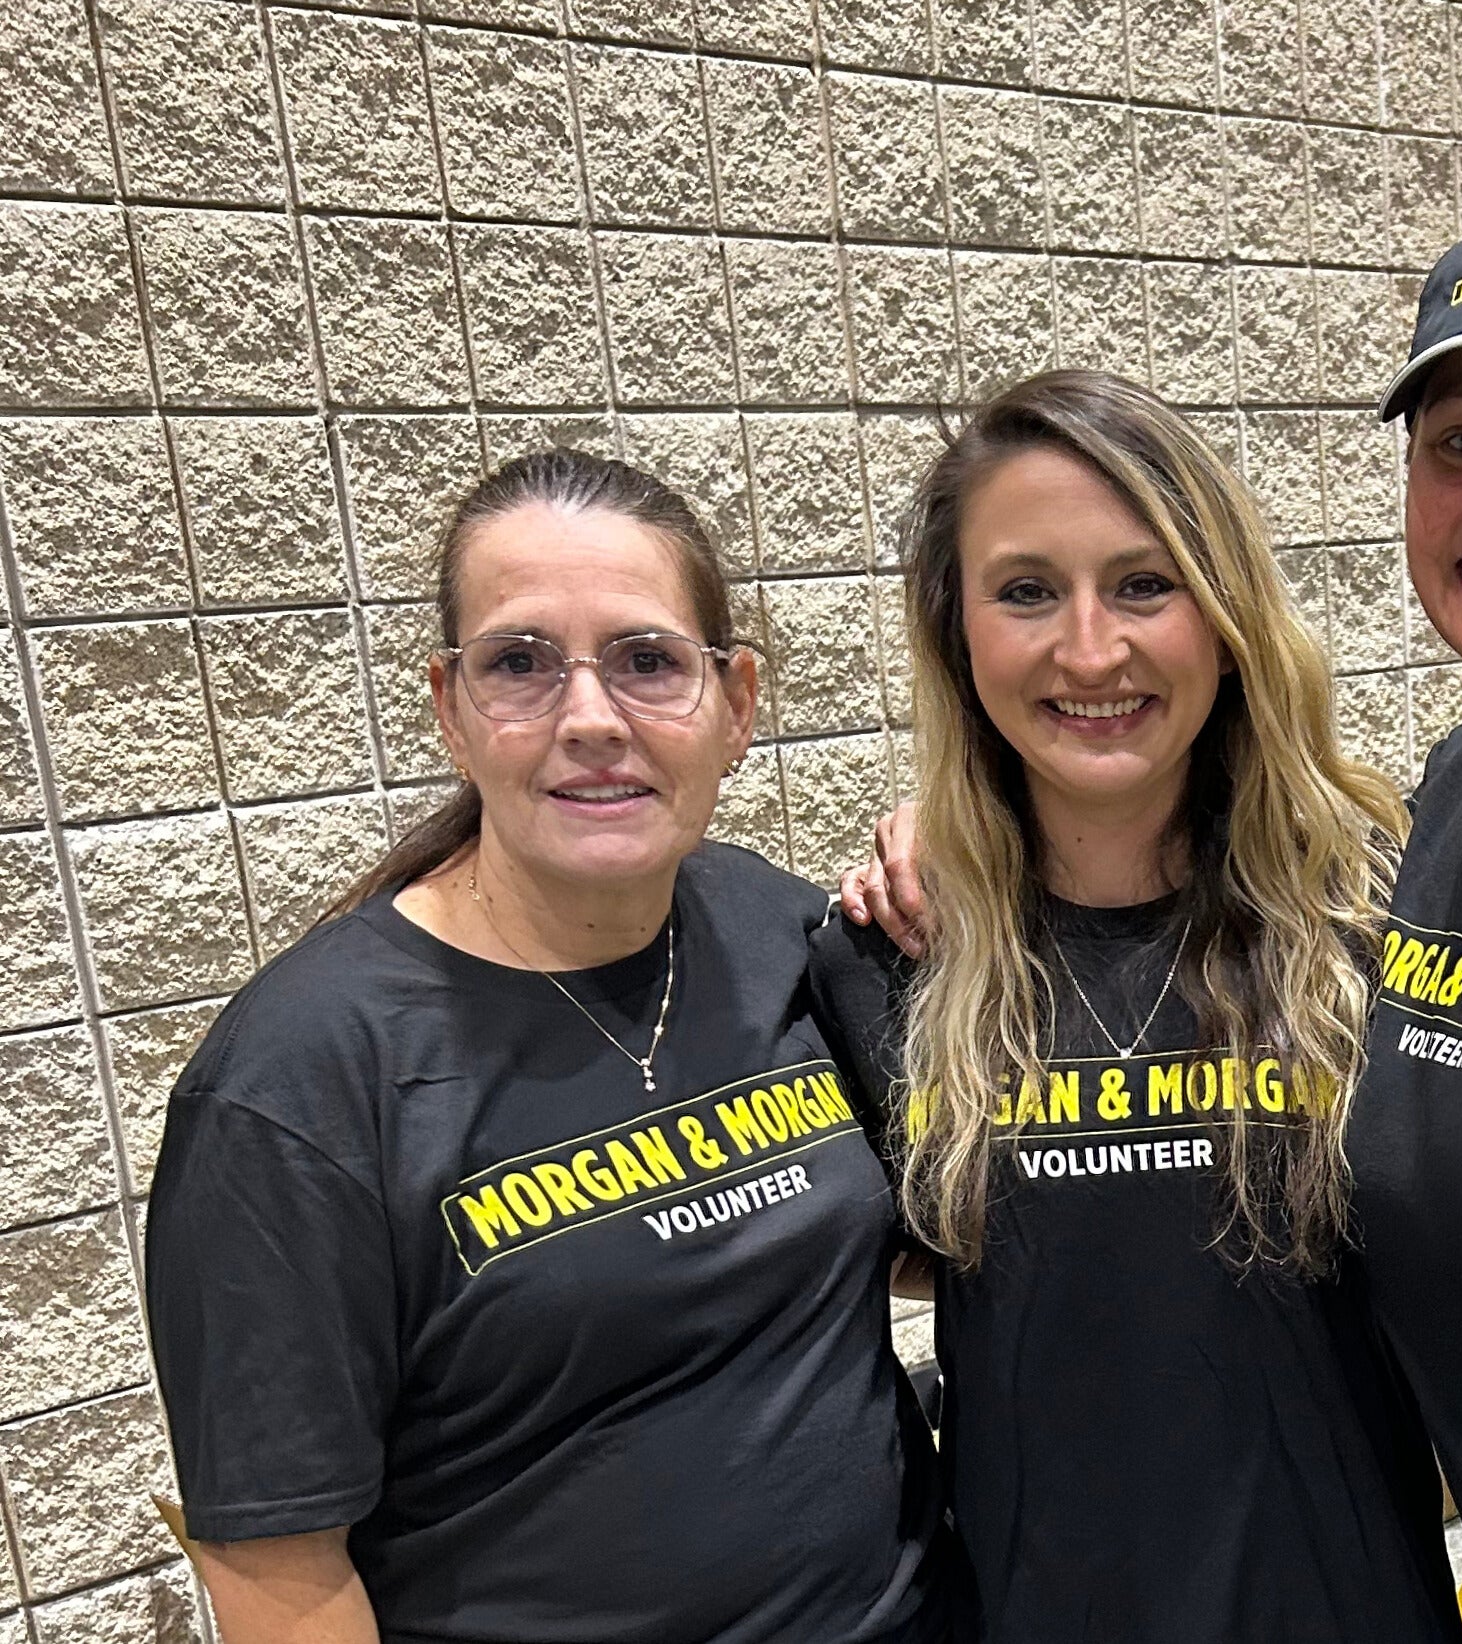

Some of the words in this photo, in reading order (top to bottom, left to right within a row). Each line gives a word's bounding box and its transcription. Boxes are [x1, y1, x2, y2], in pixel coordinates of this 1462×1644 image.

[1383, 930, 1450, 1005] ORGA
[1096, 1067, 1132, 1122] &
[458, 1124, 688, 1250] MORGAN
[677, 1114, 730, 1170] &
[715, 1070, 855, 1157] MORGAN
[1018, 1137, 1215, 1179] VOLUNTEER
[642, 1163, 812, 1242] VOLUNTEER
